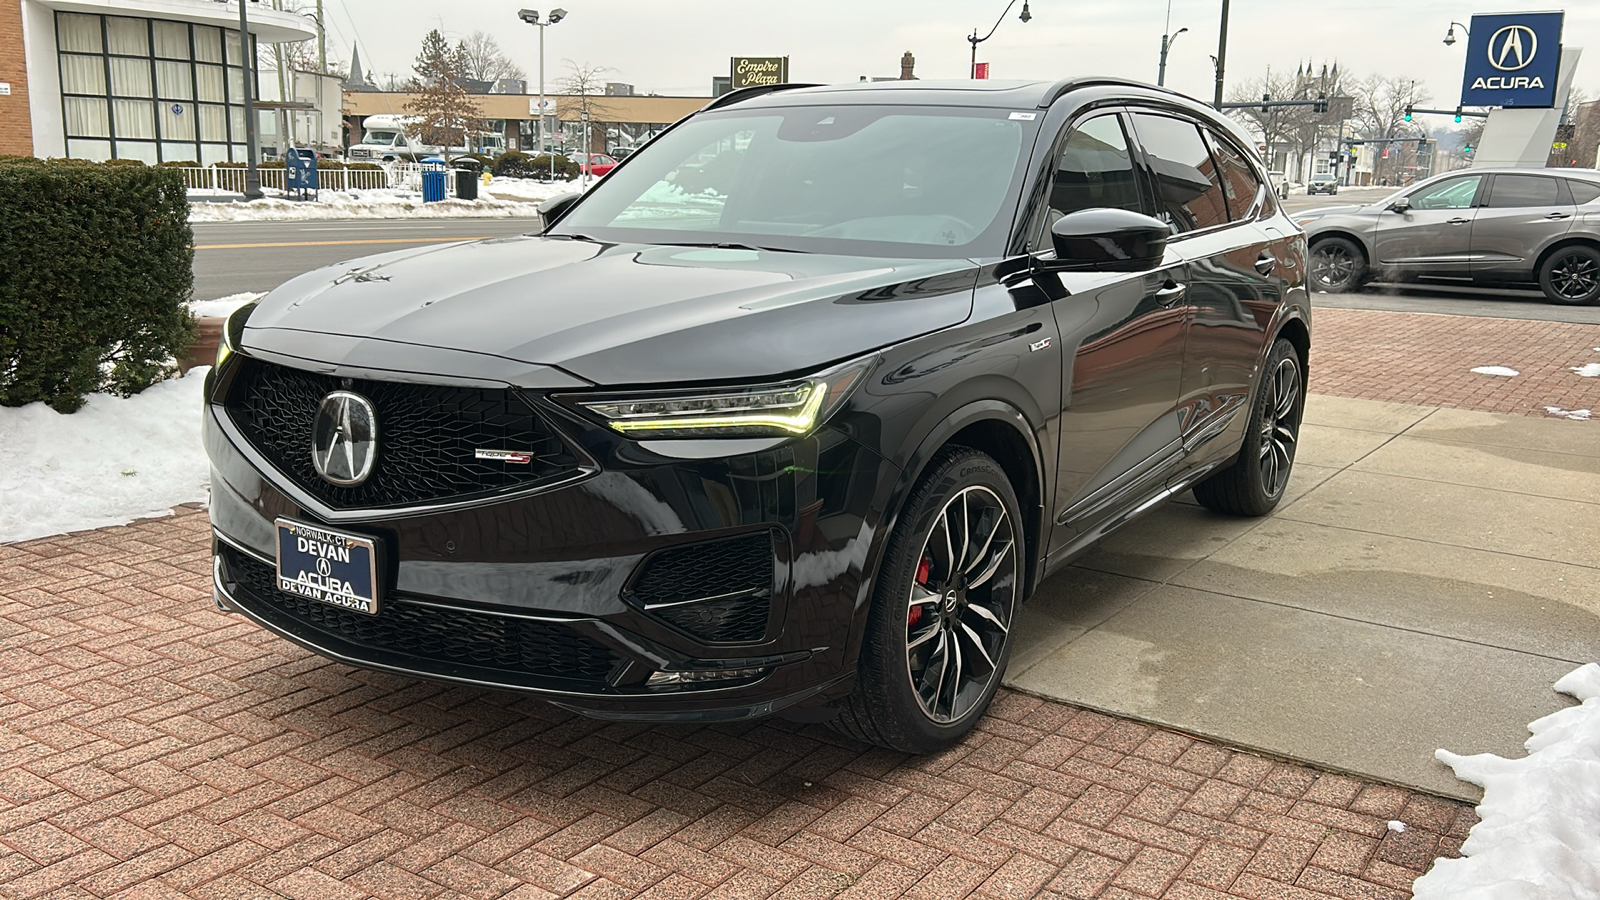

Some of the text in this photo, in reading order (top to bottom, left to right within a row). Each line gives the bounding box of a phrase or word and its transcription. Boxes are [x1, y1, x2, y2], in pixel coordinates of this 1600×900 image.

[737, 59, 778, 74] Empire
[741, 72, 777, 85] Plaza
[1471, 77, 1544, 89] ACURA
[335, 536, 346, 546] CT
[297, 537, 350, 563] DEVAN
[297, 570, 354, 597] ACURA
[282, 581, 369, 612] DEVAN ACURA
